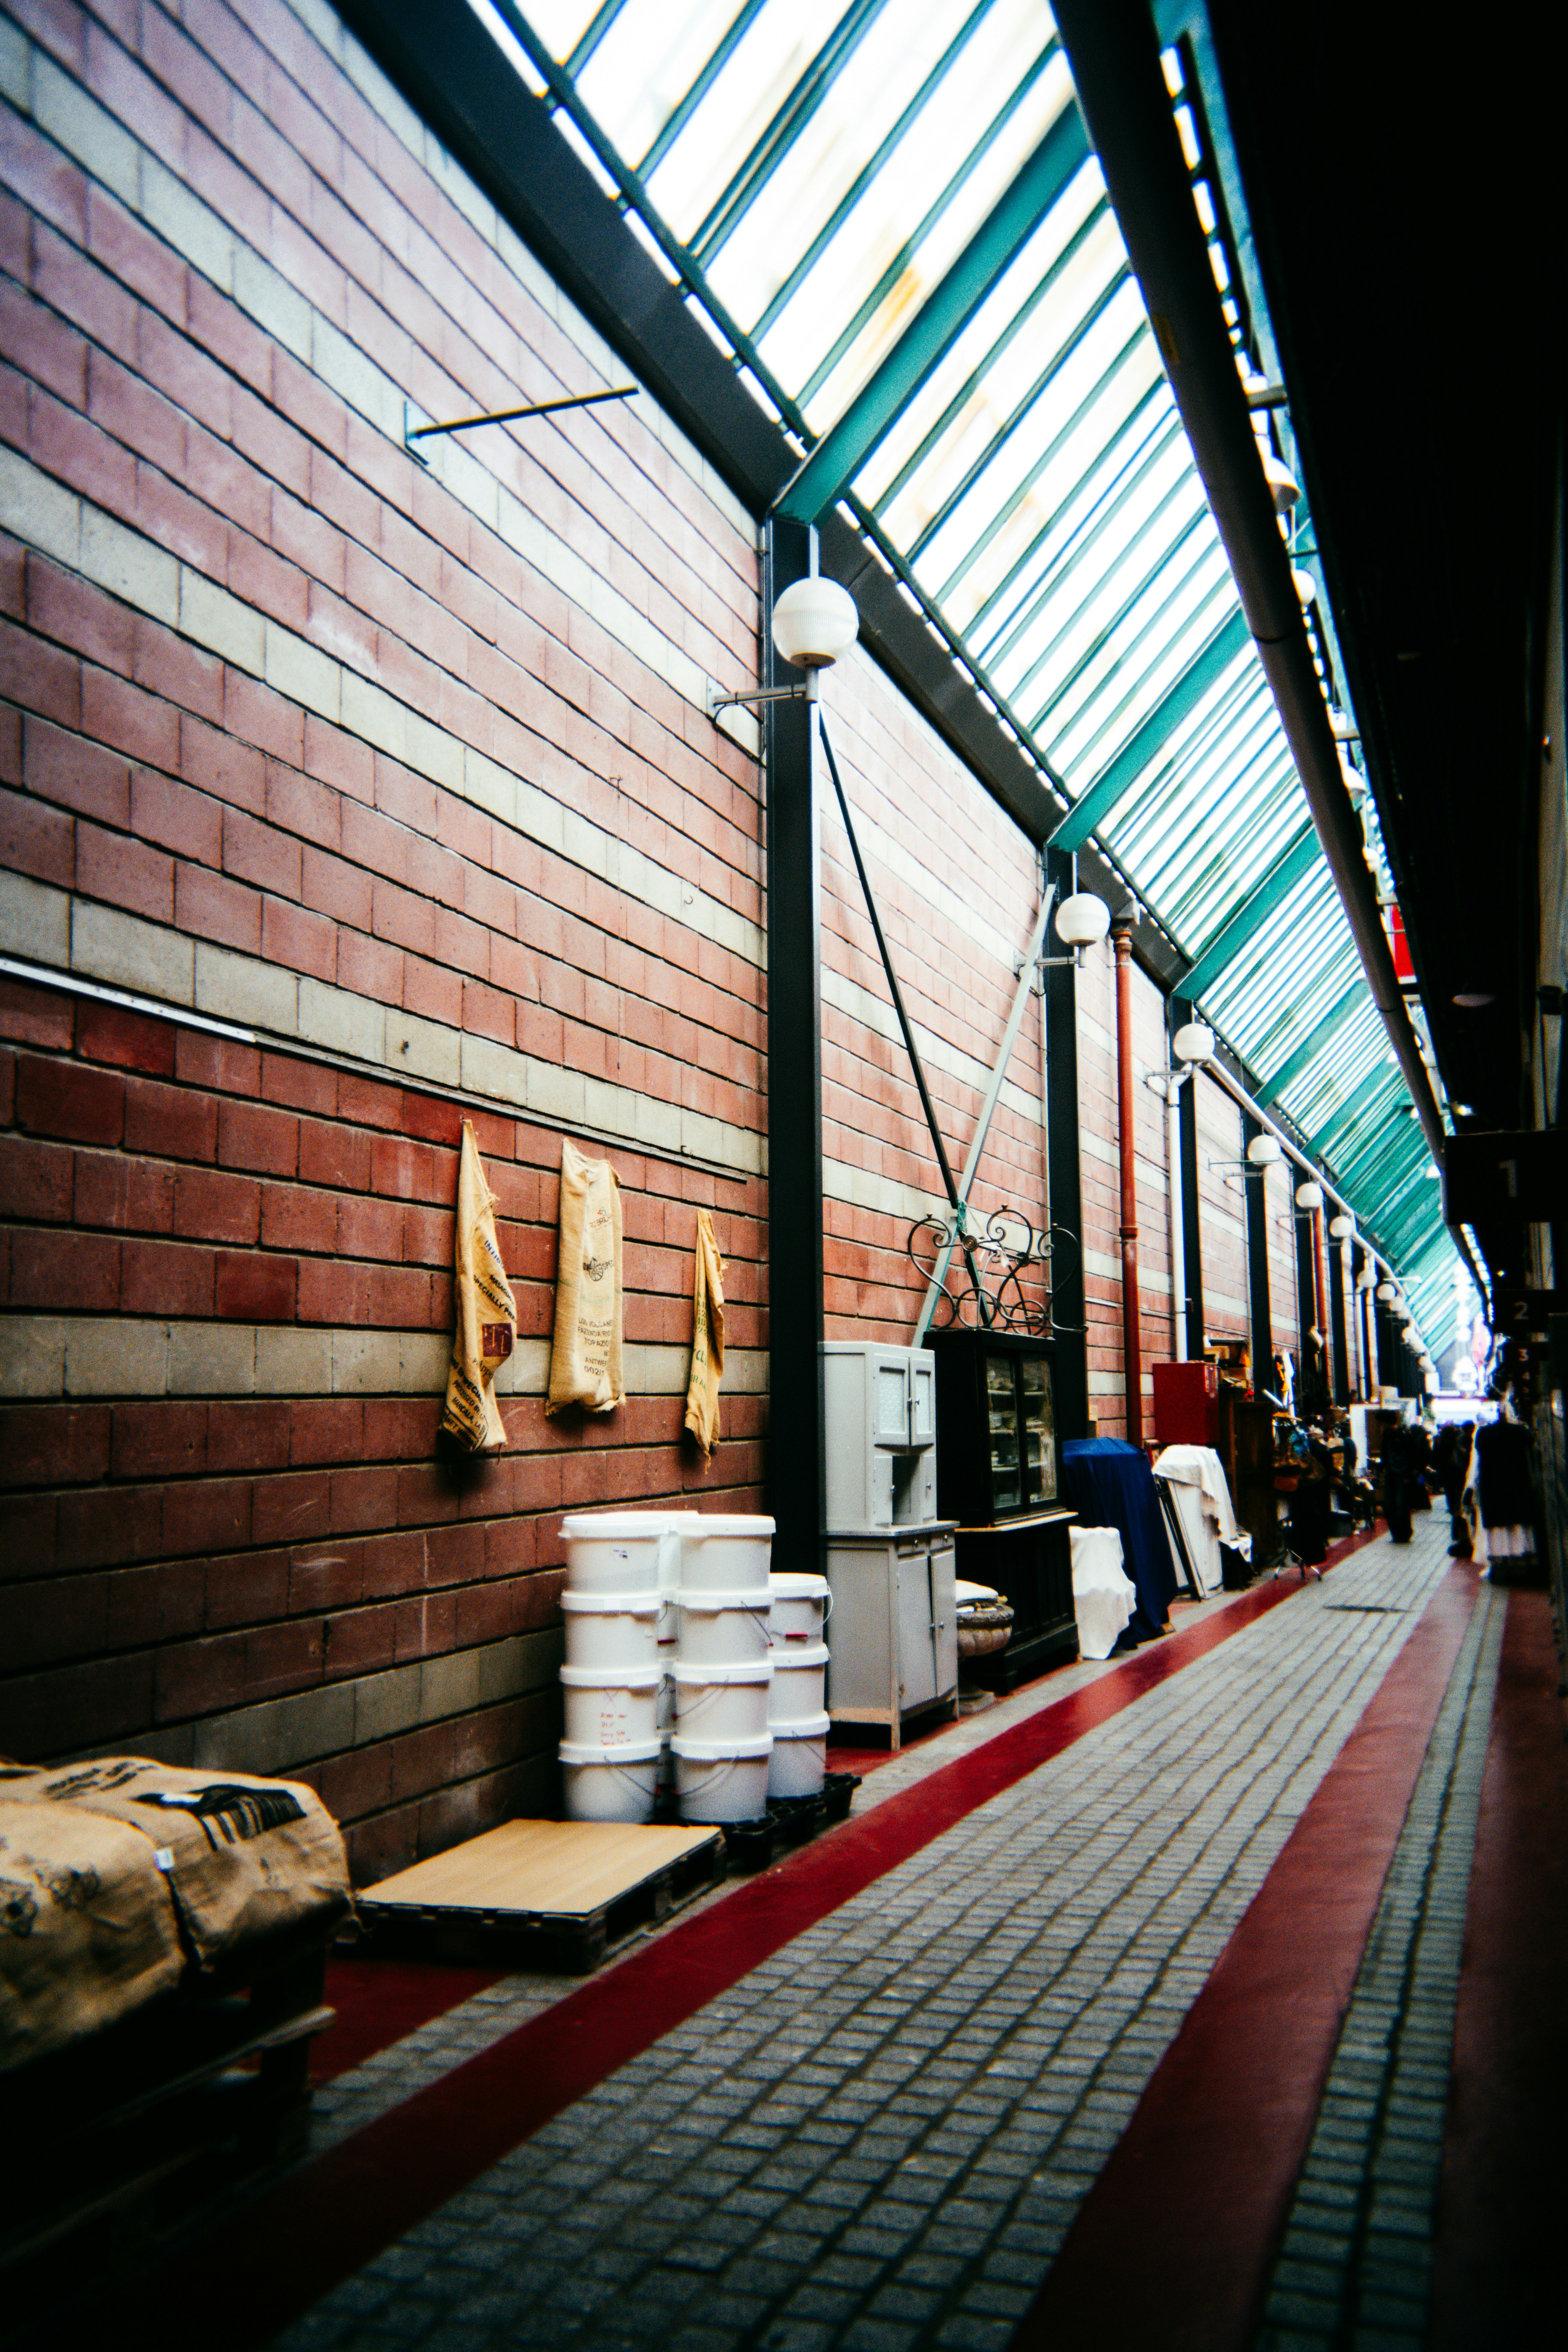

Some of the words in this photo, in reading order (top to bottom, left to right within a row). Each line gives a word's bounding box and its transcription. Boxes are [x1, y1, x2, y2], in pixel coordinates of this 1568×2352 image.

[1498, 1160, 1517, 1198] 1
[1514, 1301, 1528, 1320] 2
[1518, 1348, 1528, 1361] 3
